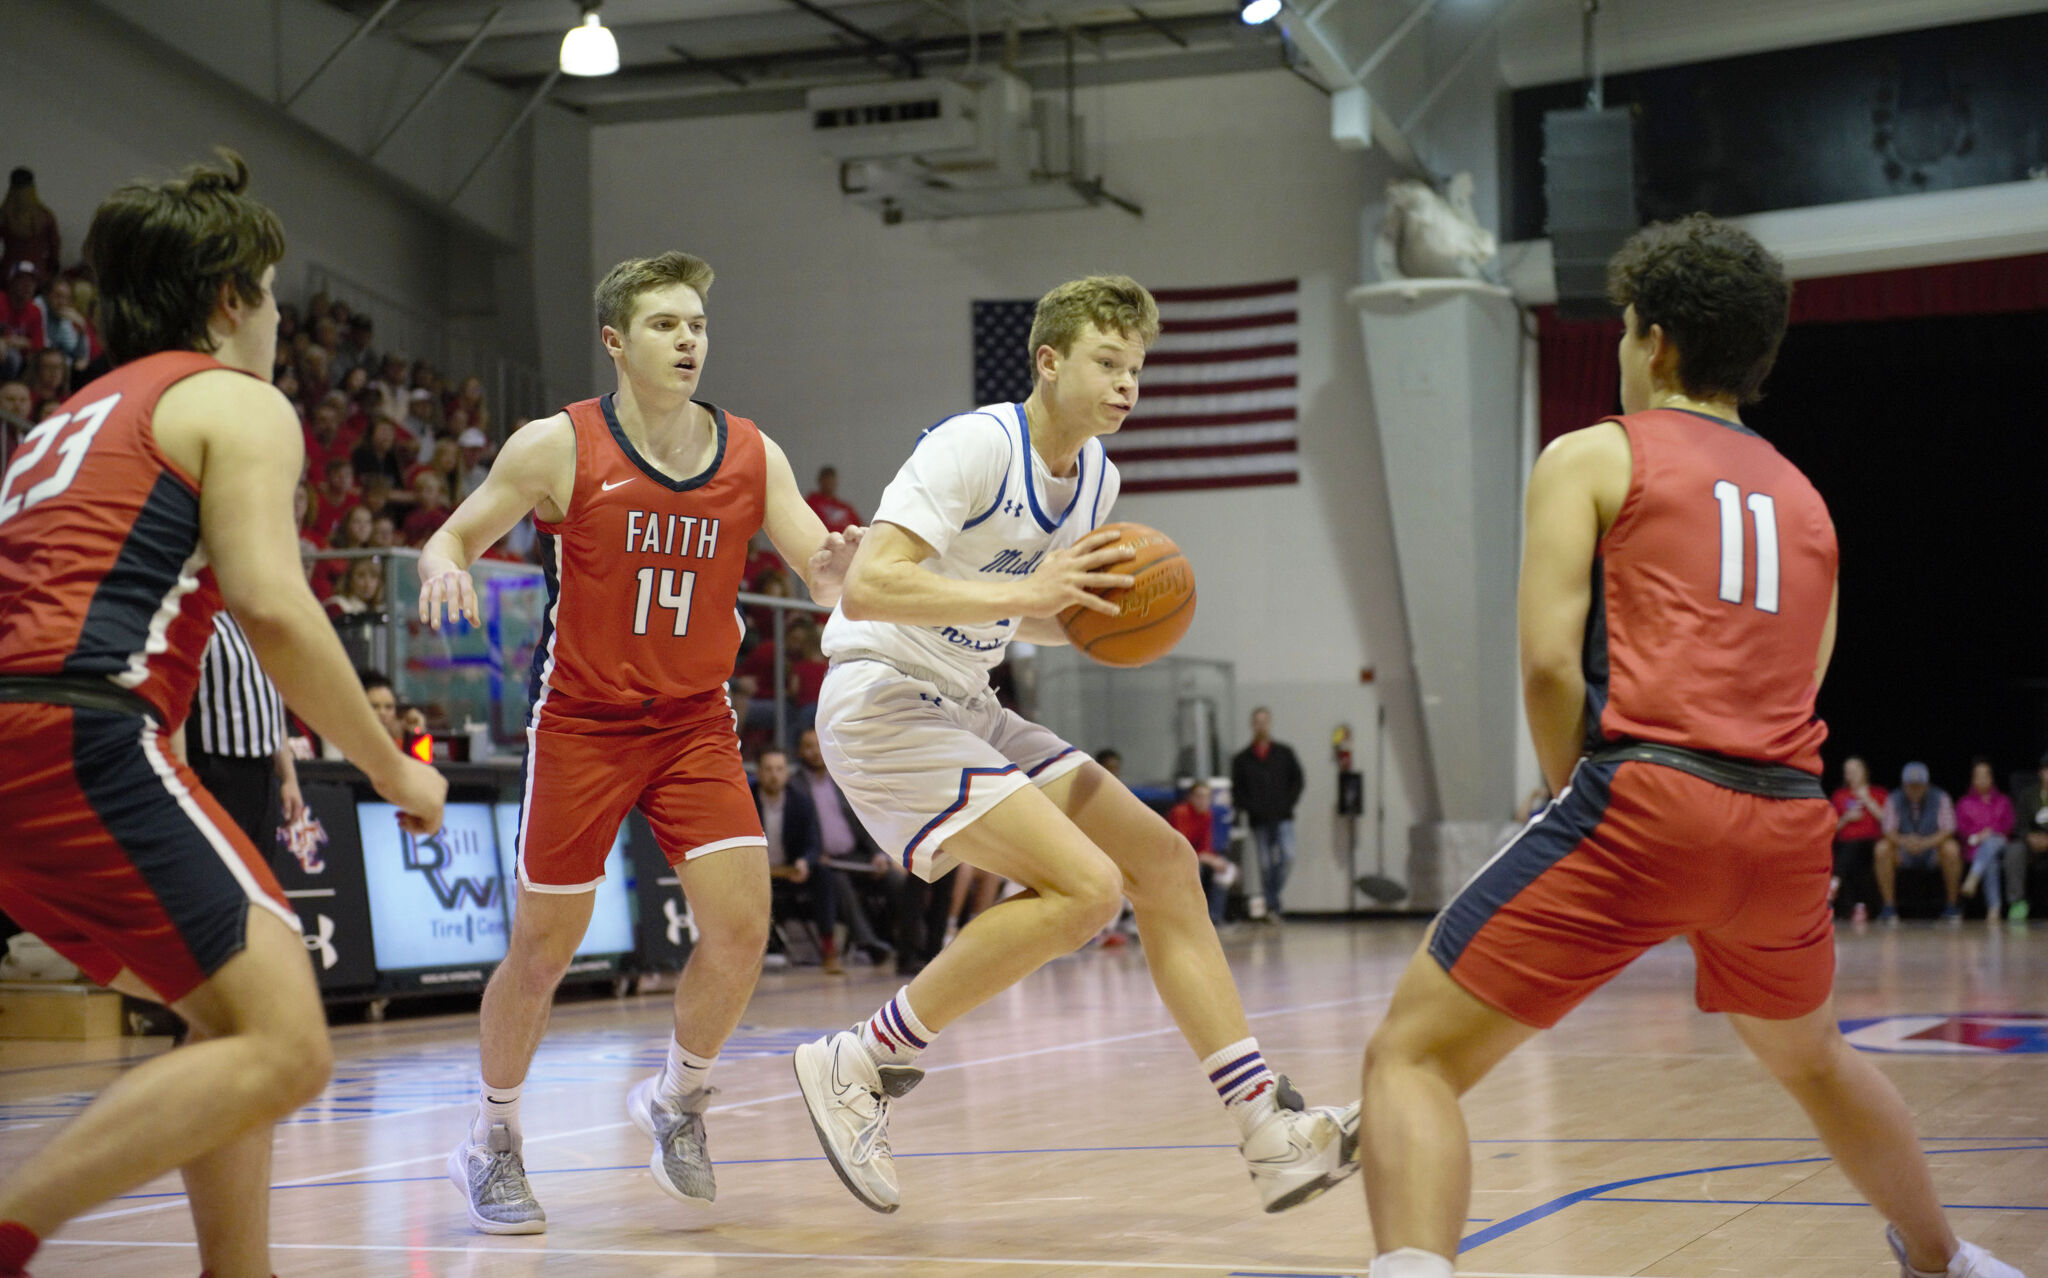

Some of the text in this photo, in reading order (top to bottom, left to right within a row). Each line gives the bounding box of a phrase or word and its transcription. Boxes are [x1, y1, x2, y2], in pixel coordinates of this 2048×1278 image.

[0, 392, 122, 525] 23
[625, 510, 720, 559] FAITH
[1714, 479, 1780, 615] 11
[632, 567, 697, 637] 14
